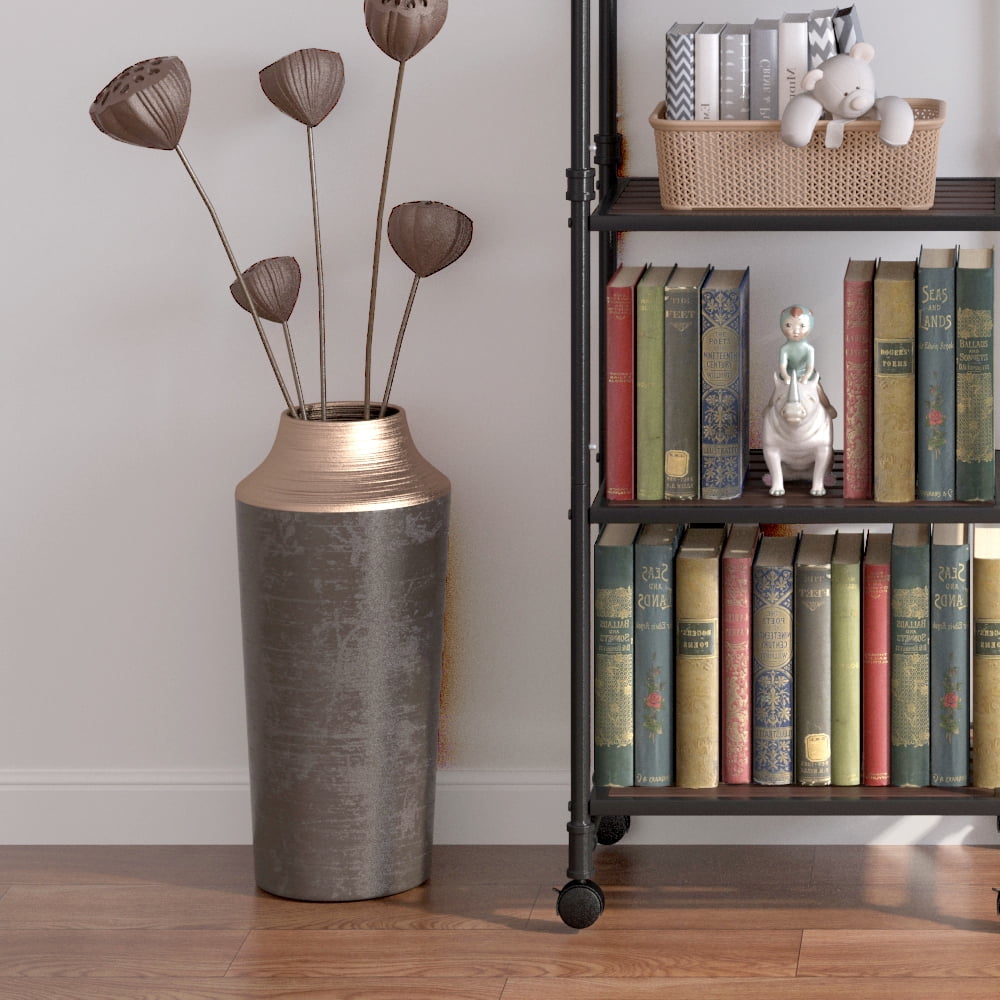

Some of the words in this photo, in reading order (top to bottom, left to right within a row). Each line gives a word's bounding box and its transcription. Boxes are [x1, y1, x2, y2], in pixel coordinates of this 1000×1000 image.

[921, 285, 949, 304] SEAS
[918, 309, 953, 331] LANDS
[959, 340, 989, 348] BALLADS
